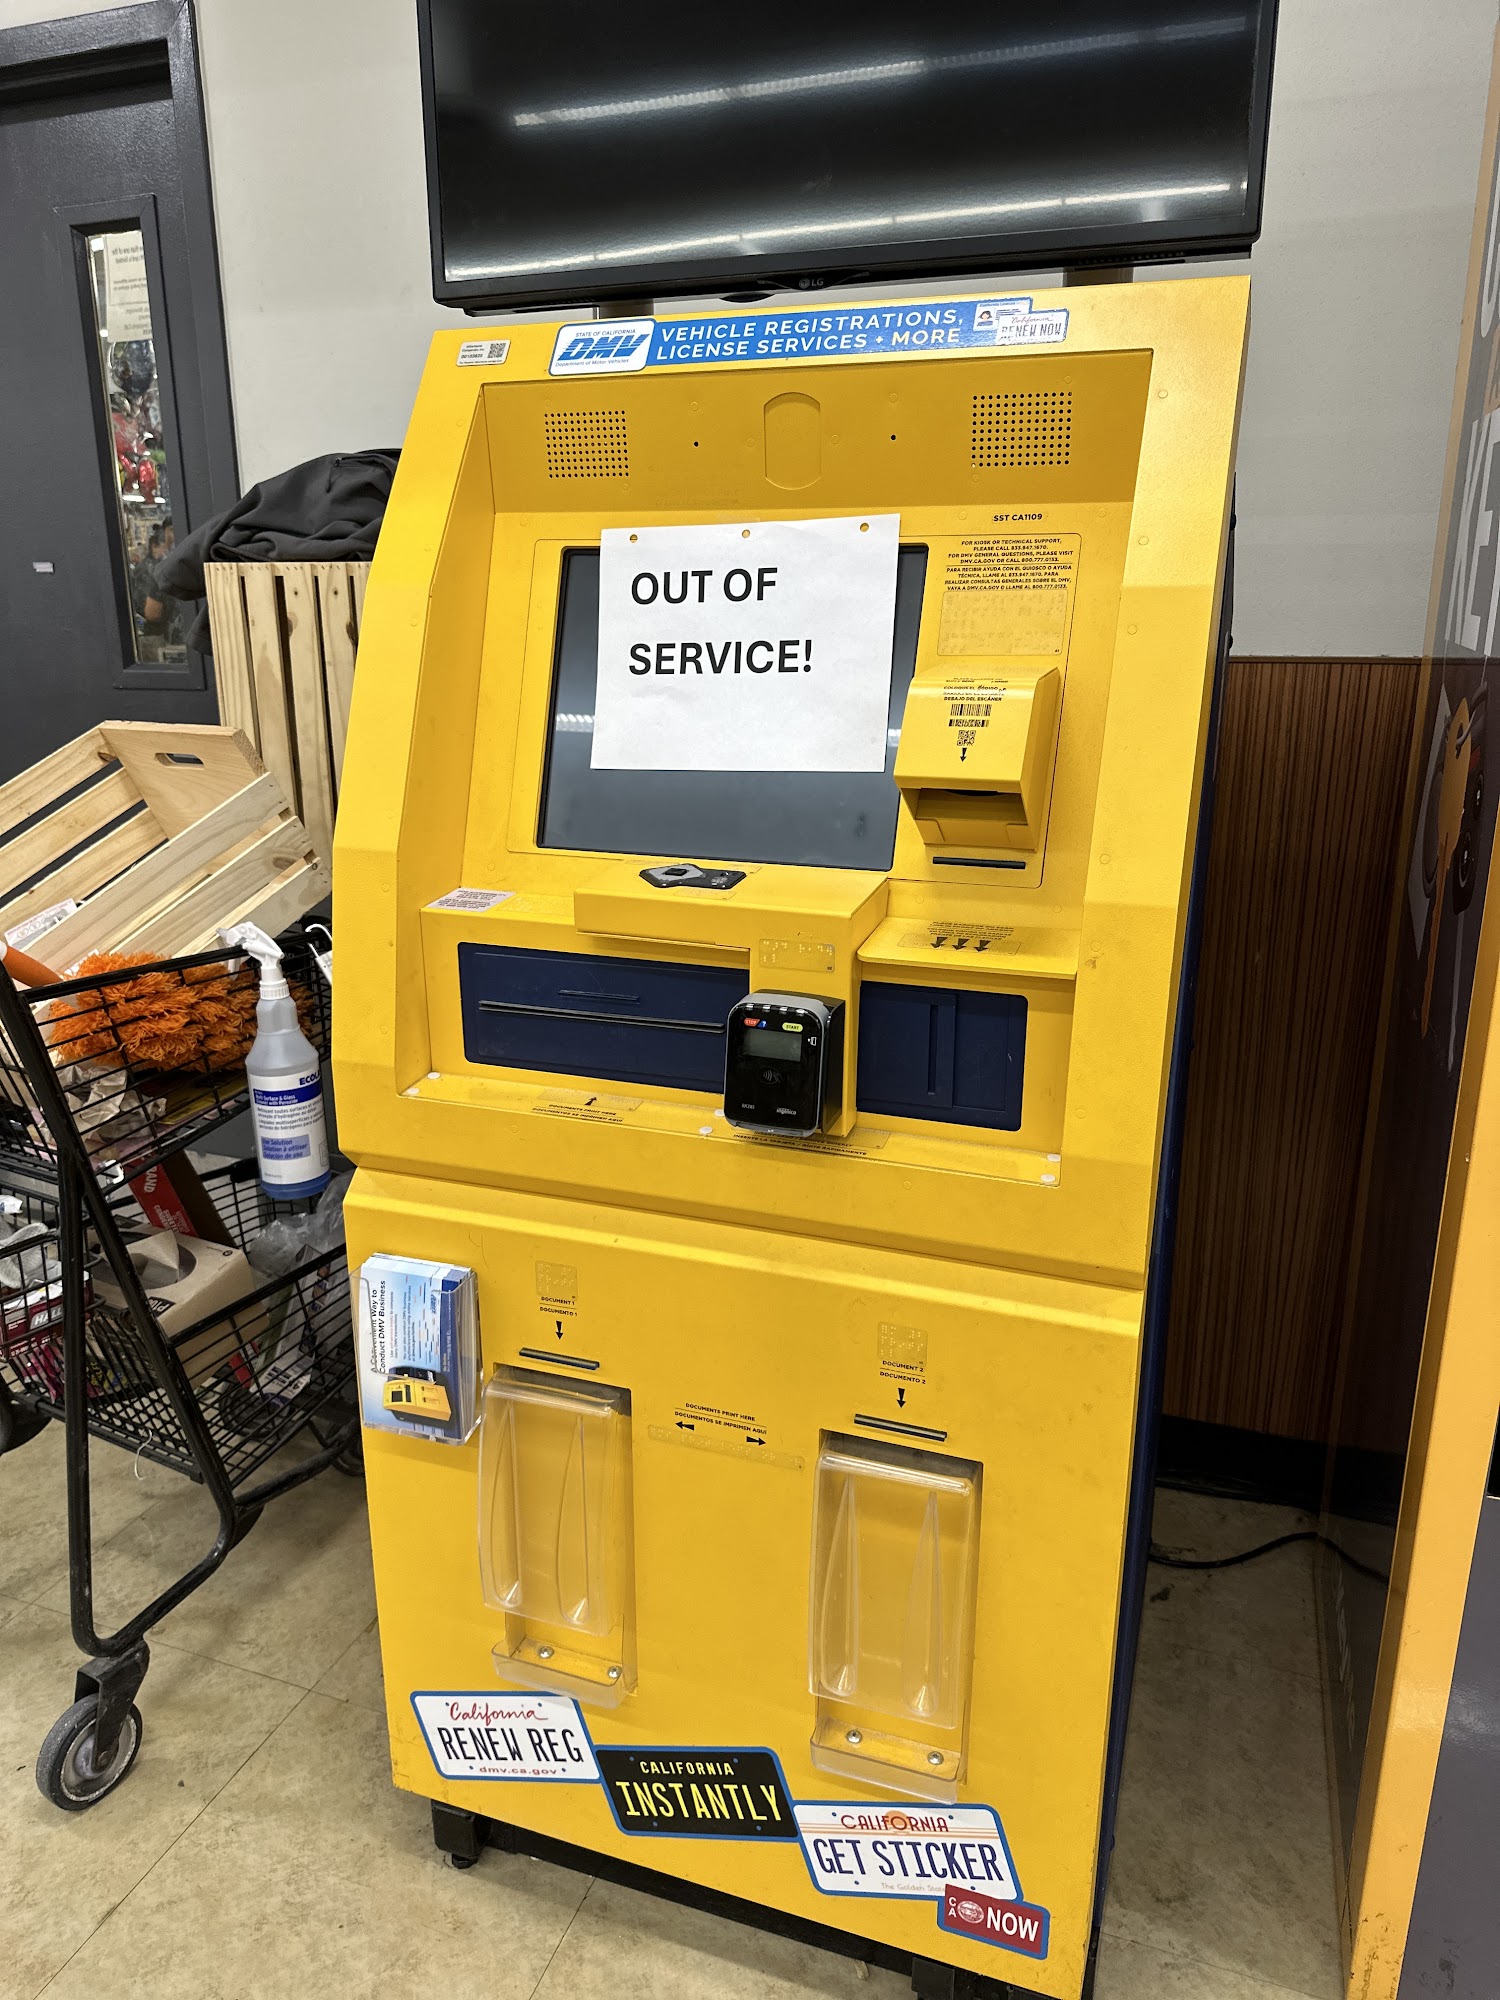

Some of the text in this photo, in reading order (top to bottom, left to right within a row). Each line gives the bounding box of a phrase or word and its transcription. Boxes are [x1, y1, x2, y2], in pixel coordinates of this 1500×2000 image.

[812, 278, 824, 286] LG
[662, 309, 963, 342] VEHICLE REGISTRATIONS,
[1012, 316, 1053, 325] California
[1002, 322, 1062, 338] RENEW NOW
[557, 334, 650, 361] DMV
[656, 341, 750, 361] LICENSE
[756, 333, 867, 354] SERVICES
[891, 328, 961, 346] MORE
[631, 568, 778, 605] OUT OF
[629, 640, 812, 675] SERVICE!
[290, 1105, 308, 1113] surfaces
[549, 1104, 583, 1112] DOCUMENTS
[288, 1144, 308, 1152] utiliser
[144, 1166, 158, 1193] RAND
[371, 1290, 377, 1298] to
[541, 1296, 572, 1305] DOCUMENT
[34, 1308, 64, 1326] HALL
[371, 1300, 379, 1317] Way
[540, 1307, 574, 1316] DOCUMENTO
[882, 1360, 919, 1371] DOCUMENT
[880, 1371, 921, 1383] DOCUMENTO
[686, 1403, 721, 1414] DOCUMENTS
[675, 1411, 714, 1424] DOCUMENTOS
[724, 1422, 751, 1431] IMPRIMEN
[450, 1701, 549, 1727] California
[437, 1727, 584, 1763] RENEW REG
[479, 1767, 558, 1776] dmv.ca.gov
[640, 1761, 735, 1776] CALIFORNIA
[615, 1781, 782, 1821] INSTANTLY
[841, 1814, 949, 1833] CALIFORNIA
[813, 1838, 1005, 1882] GET STICKER
[987, 1906, 1039, 1942] NOW
